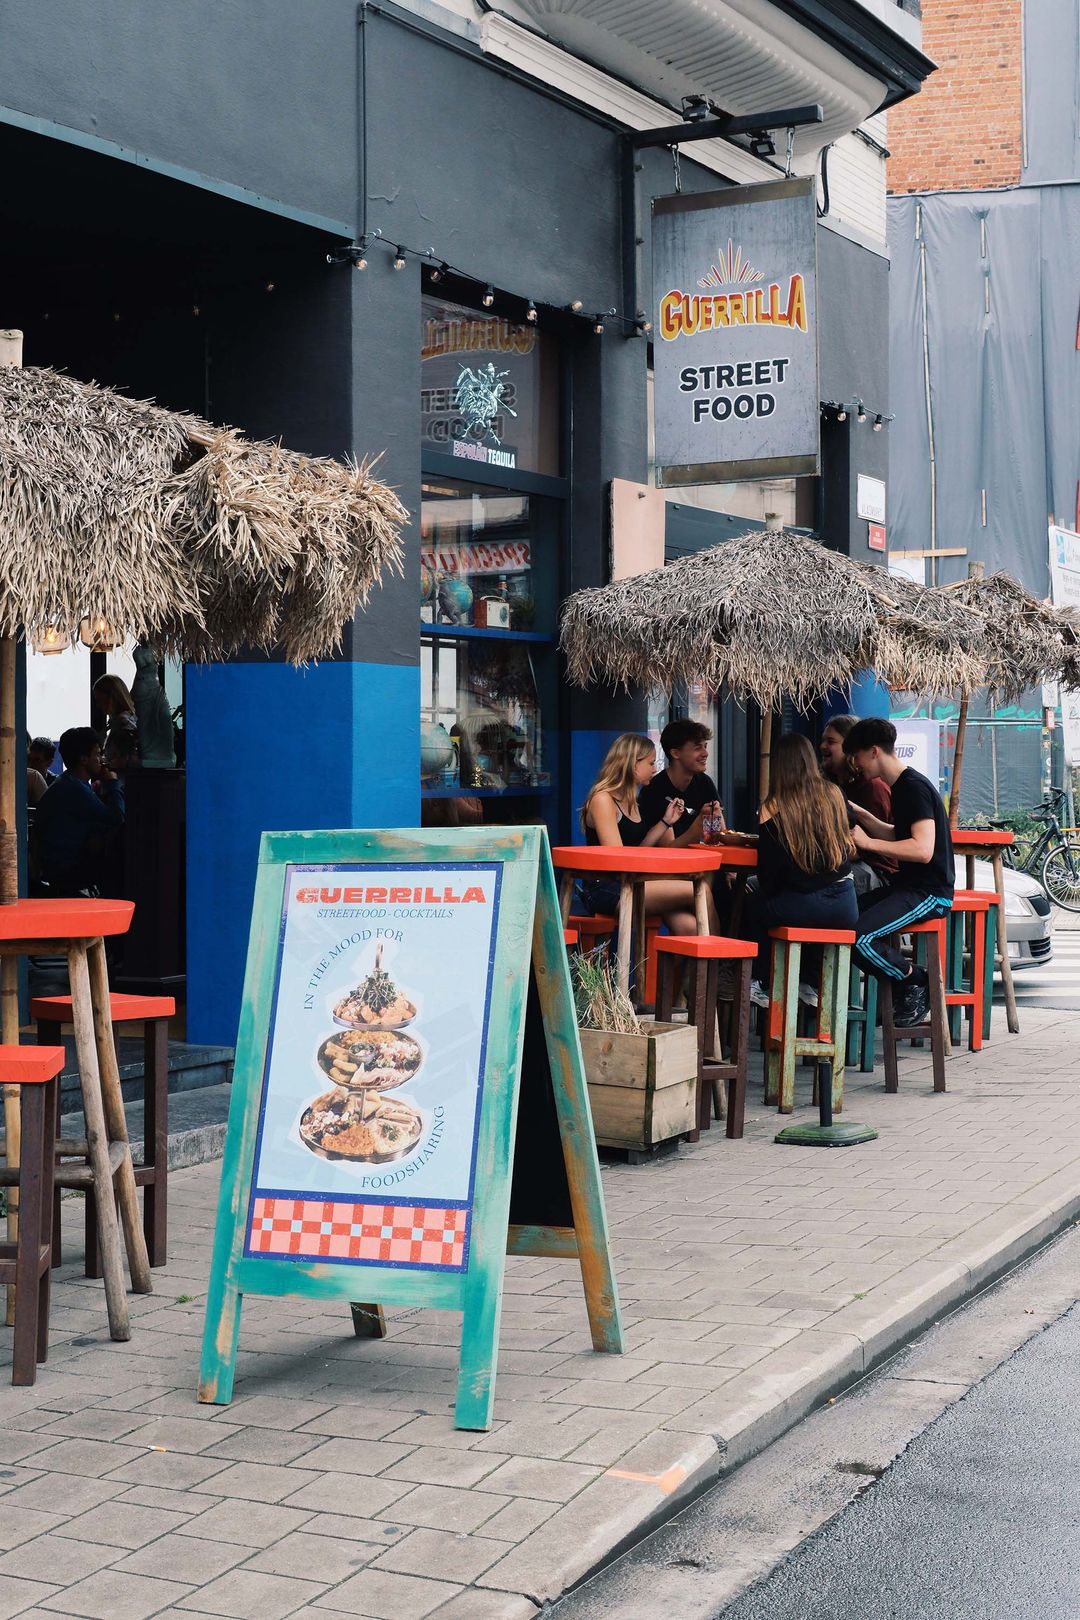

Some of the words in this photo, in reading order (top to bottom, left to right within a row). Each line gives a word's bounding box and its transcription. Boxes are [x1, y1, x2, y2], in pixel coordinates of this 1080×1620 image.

[660, 273, 808, 341] GUERRILLA
[679, 357, 789, 392] STREET
[692, 392, 776, 423] FOOD
[488, 448, 516, 469] TEQUILA
[296, 887, 486, 904] GUERRILLA
[393, 908, 455, 919] COCKTAILS
[329, 929, 372, 959] MOOD
[376, 928, 404, 942] FOR
[308, 959, 330, 988] THE
[304, 994, 314, 1009] IN
[361, 1106, 445, 1188] FOODSHARING
